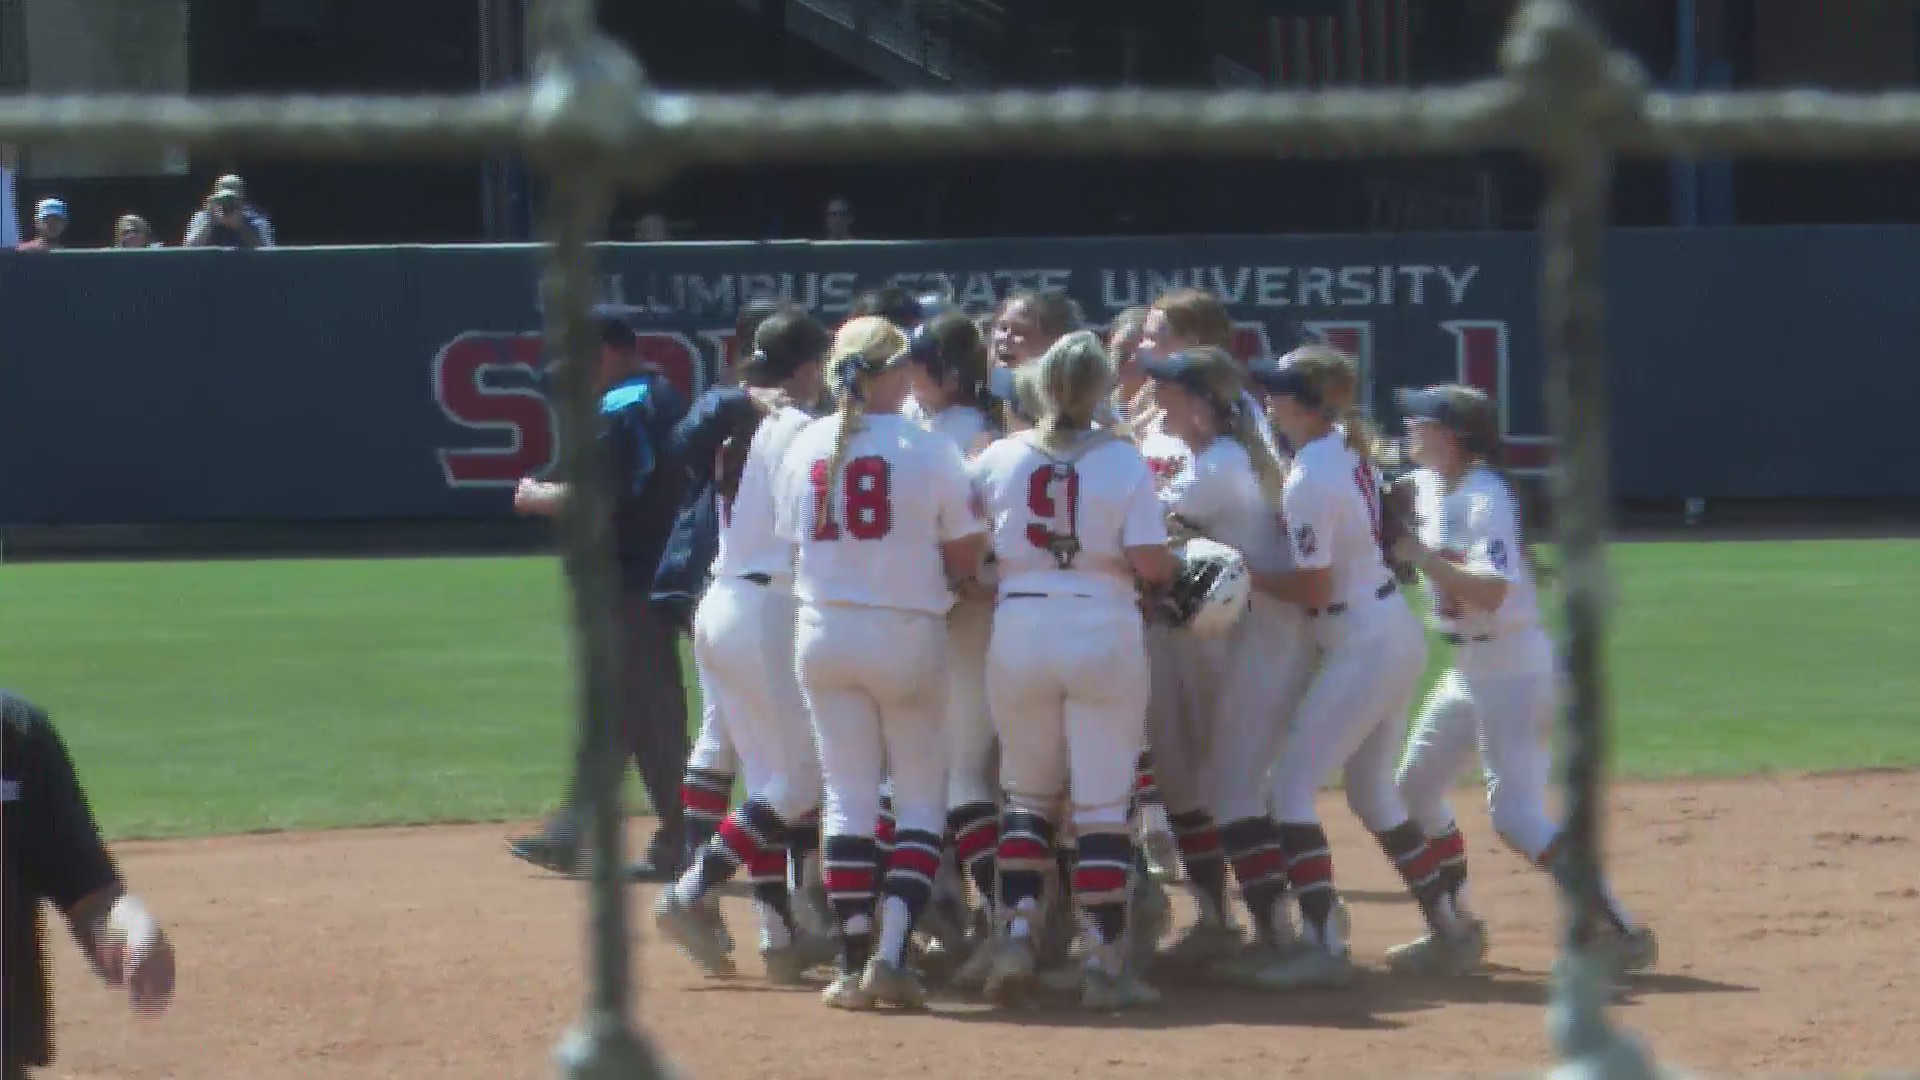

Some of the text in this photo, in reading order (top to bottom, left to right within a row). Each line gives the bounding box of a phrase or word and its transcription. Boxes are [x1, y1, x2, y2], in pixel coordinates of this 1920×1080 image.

[535, 273, 858, 313] LUMBUS
[1101, 265, 1480, 306] UNIVERSITY
[811, 455, 893, 541] 18
[1027, 464, 1080, 552] 9
